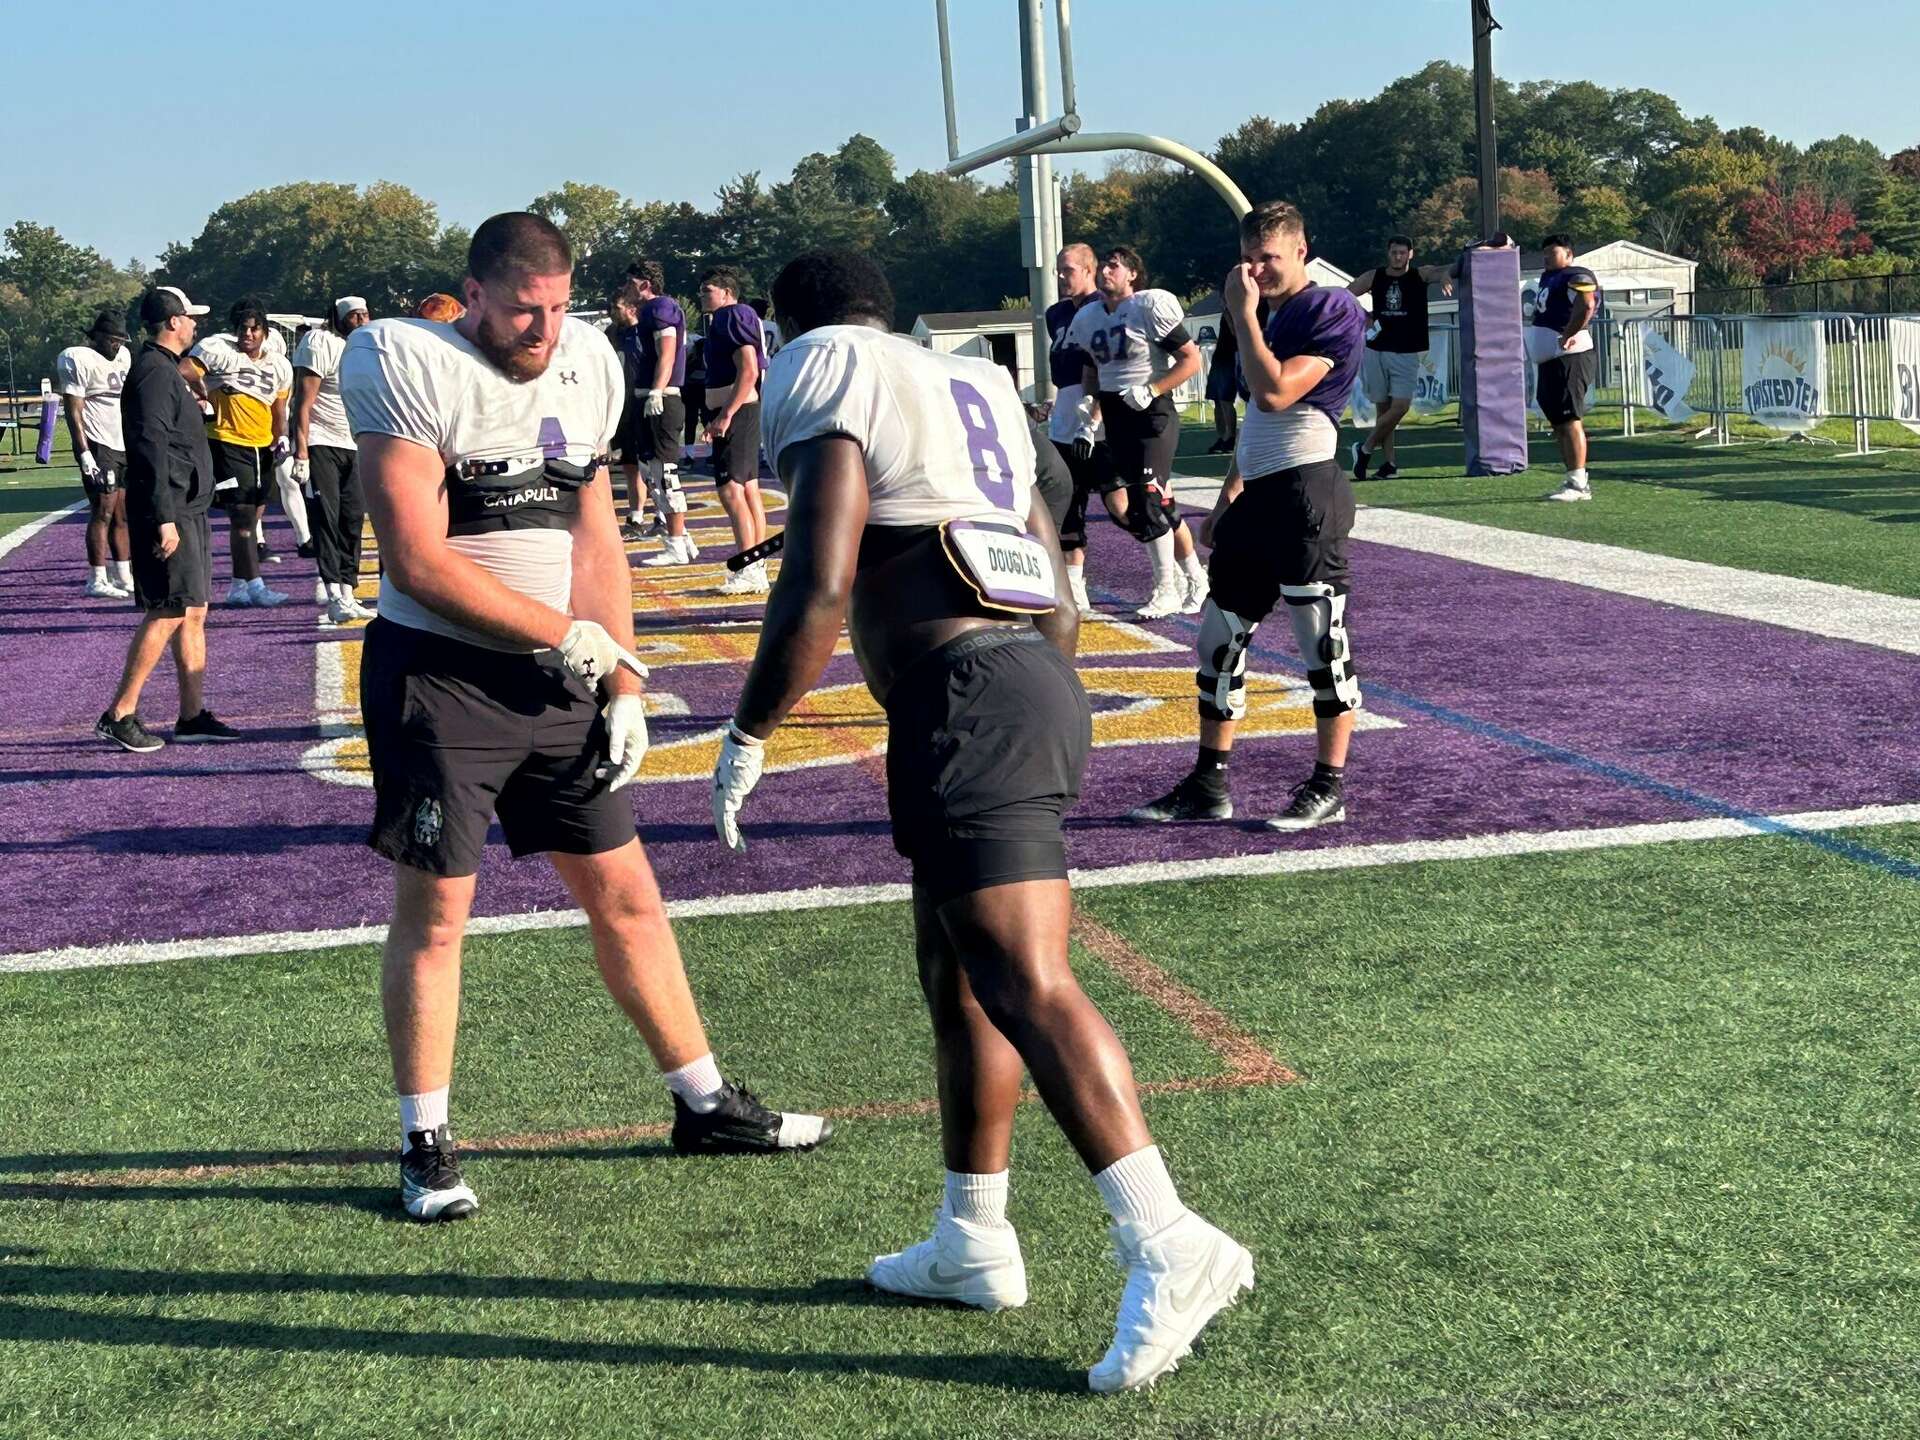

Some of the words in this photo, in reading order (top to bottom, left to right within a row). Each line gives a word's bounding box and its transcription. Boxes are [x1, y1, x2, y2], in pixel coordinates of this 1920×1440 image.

[1091, 323, 1129, 365] 97
[1744, 378, 1795, 415] TWISTED
[1795, 376, 1819, 417] TEA
[950, 378, 1016, 512] 8
[484, 486, 559, 508] CATAPULT
[988, 546, 1042, 580] DOUGLAS
